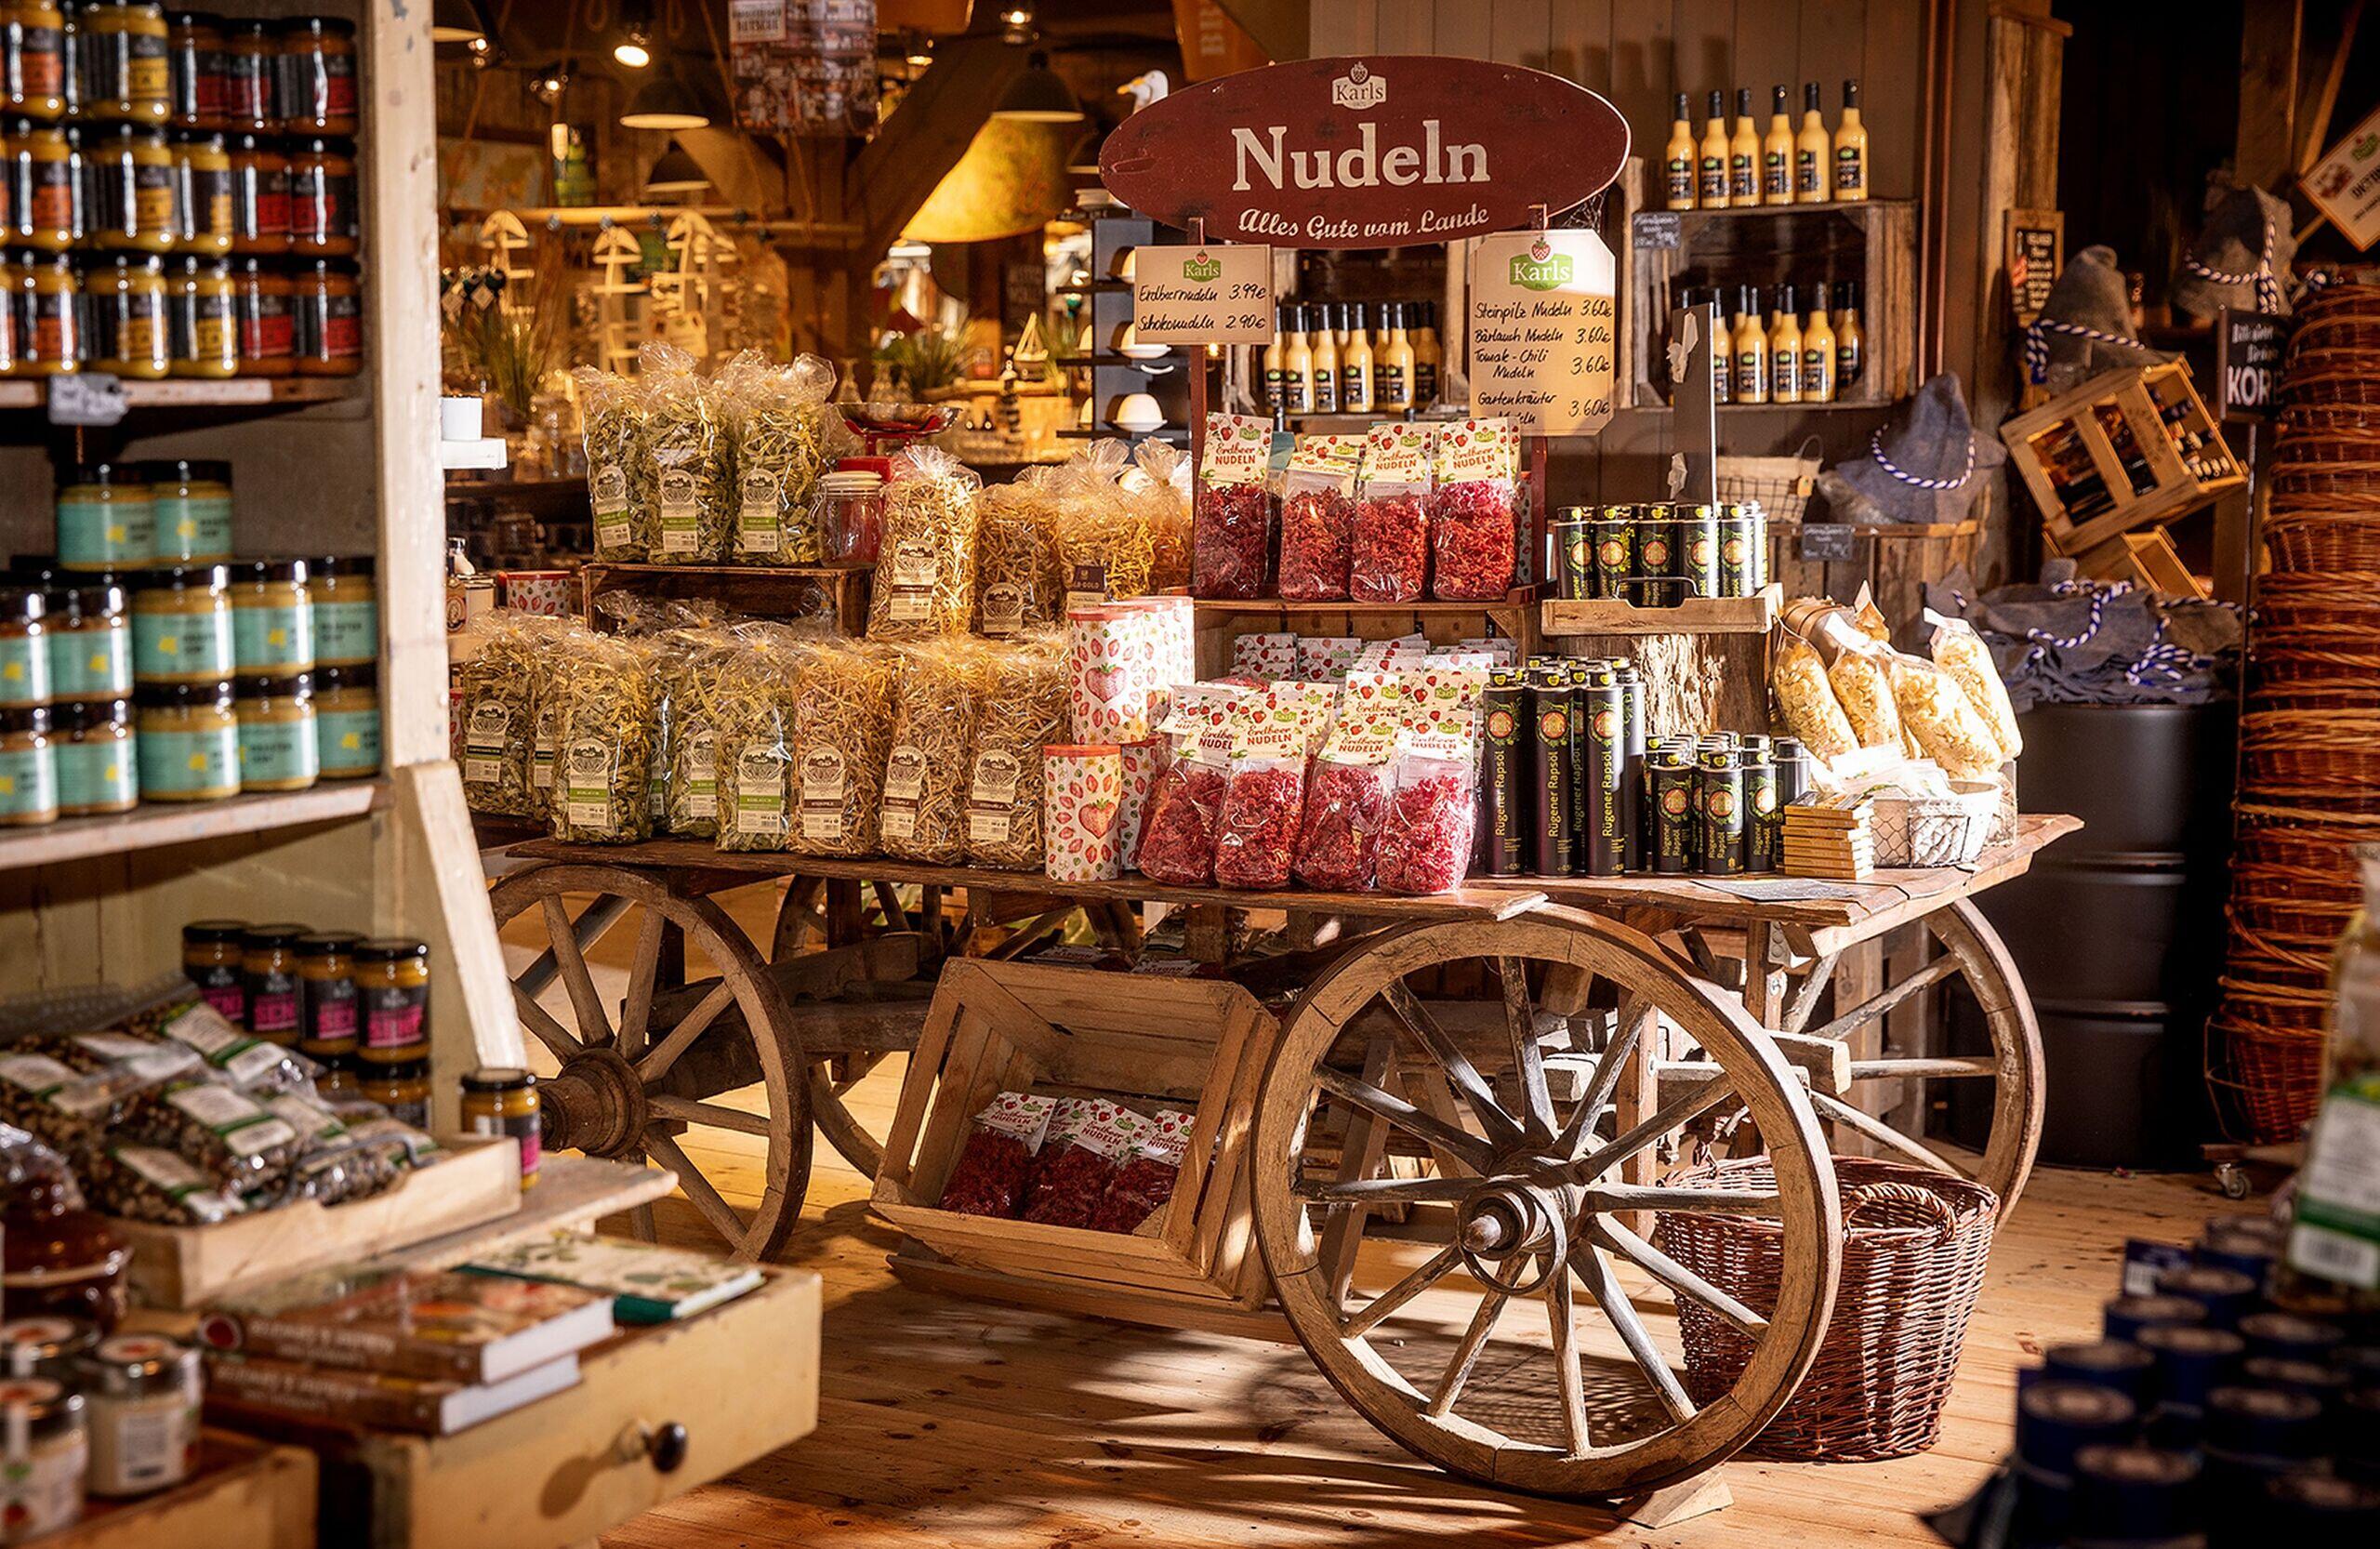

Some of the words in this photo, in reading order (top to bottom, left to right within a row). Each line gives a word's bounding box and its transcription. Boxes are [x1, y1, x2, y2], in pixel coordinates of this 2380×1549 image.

[1336, 82, 1383, 101] Karls
[1231, 119, 1490, 192] Nudeln
[1238, 207, 1299, 235] Alles
[1306, 215, 1359, 240] Gute
[1364, 219, 1412, 238] vom
[1417, 204, 1489, 233] Lande
[1185, 263, 1220, 277] Karls
[1514, 260, 1571, 282] Karls
[1139, 284, 1218, 302] Erdbeernudeln
[1228, 283, 1267, 300] 3.99€
[1474, 301, 1527, 324] Steinpilz
[1531, 299, 1572, 317] Nudeln
[1580, 298, 1613, 318] 3.60€
[1138, 312, 1215, 332] Schokonudeln
[1474, 326, 1522, 343] Bärlauch
[1525, 327, 1564, 342] Nudeln
[1575, 325, 1612, 344] 3.60€
[1492, 364, 1535, 378] Nudeln
[1570, 354, 1611, 376] 3.60€
[1477, 390, 1557, 405] Gartenkräuter
[1568, 399, 1610, 417] 3.60€
[1216, 442, 1255, 455] Erdbeer
[1215, 455, 1256, 465] NUDELN
[1376, 459, 1417, 470] NUDELN
[1453, 454, 1495, 470] NUDELN
[1247, 724, 1291, 736] Erdbeer
[1247, 734, 1292, 745] NUDELN
[1198, 738, 1233, 750] NUDEL
[1339, 744, 1384, 752] NUDELN
[1494, 749, 1507, 788] Rapsöl
[1547, 750, 1561, 789] Rapsöl
[1601, 750, 1614, 789] Rapsöl
[1494, 790, 1509, 836] Rügener
[1548, 791, 1562, 838] Rügener
[1601, 790, 1616, 837] Rügener
[990, 1114, 1031, 1125] NUDELN
[1081, 1128, 1122, 1146] NUDELN
